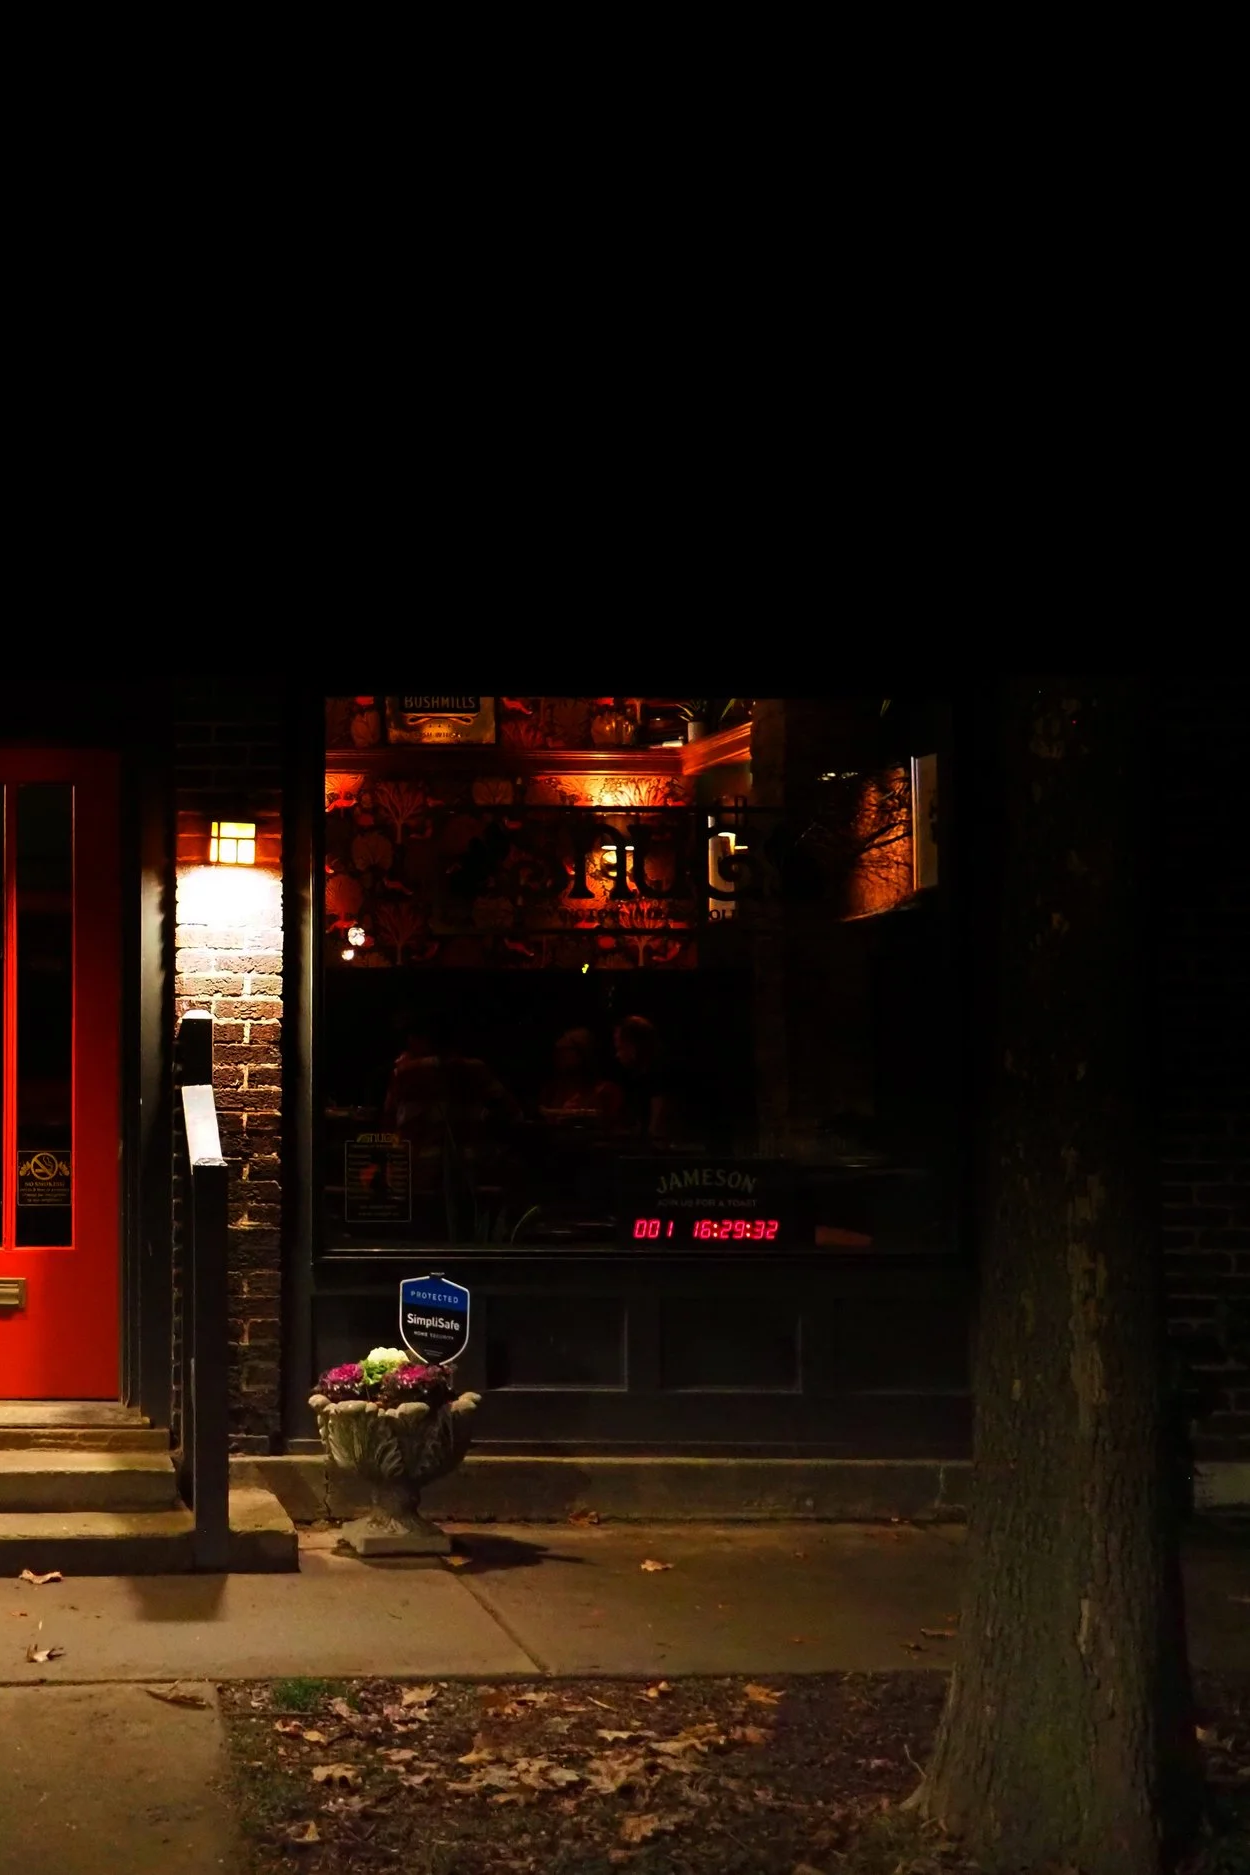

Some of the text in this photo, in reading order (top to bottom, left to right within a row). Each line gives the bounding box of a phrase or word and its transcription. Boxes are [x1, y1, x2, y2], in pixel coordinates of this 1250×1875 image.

[404, 695, 476, 709] BUSHMILLS
[656, 1168, 757, 1194] JAMESON
[693, 1218, 780, 1240] 16:29:32
[410, 1290, 459, 1304] PROTECTED
[407, 1312, 460, 1331] SimpliSafe
